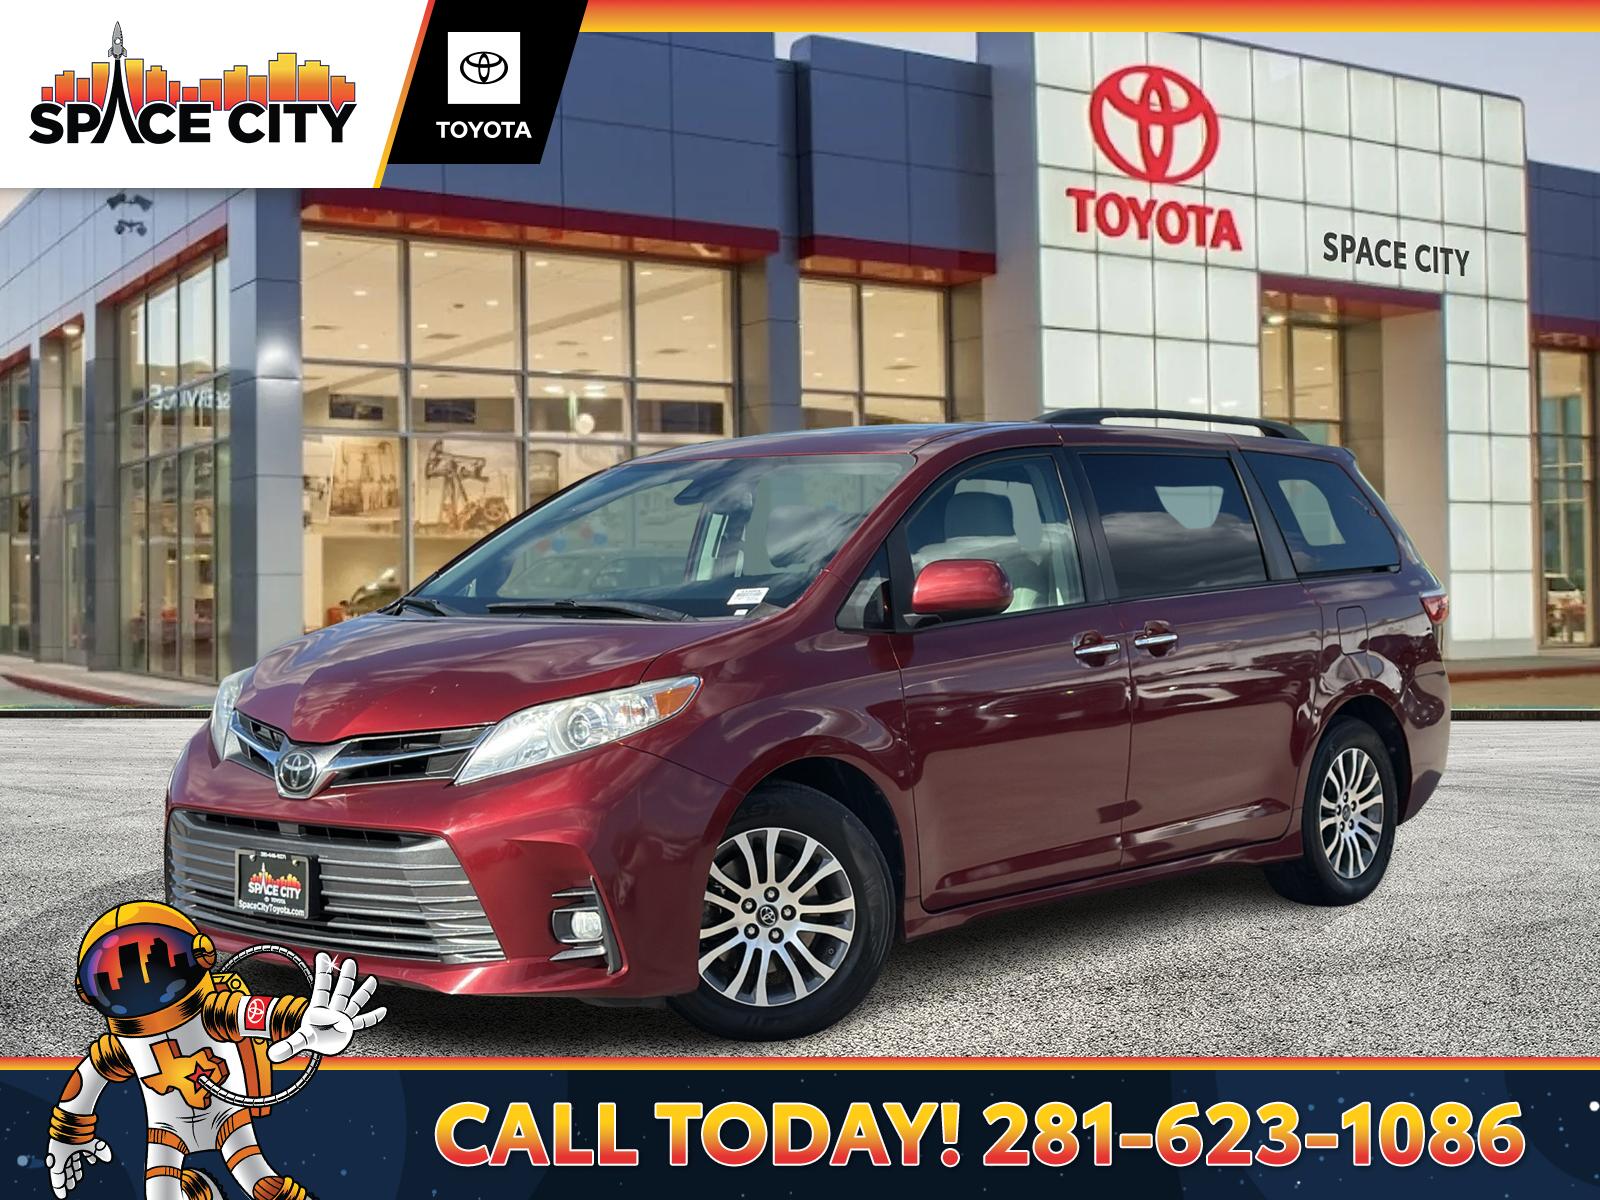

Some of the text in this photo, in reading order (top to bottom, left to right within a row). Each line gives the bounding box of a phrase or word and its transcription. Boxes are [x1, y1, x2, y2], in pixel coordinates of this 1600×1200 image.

[1066, 187, 1242, 251] TOYOTA
[1323, 232, 1470, 277] SPACE CITY
[238, 899, 304, 916] SpaceCityToyota.com
[280, 886, 301, 899] CITY
